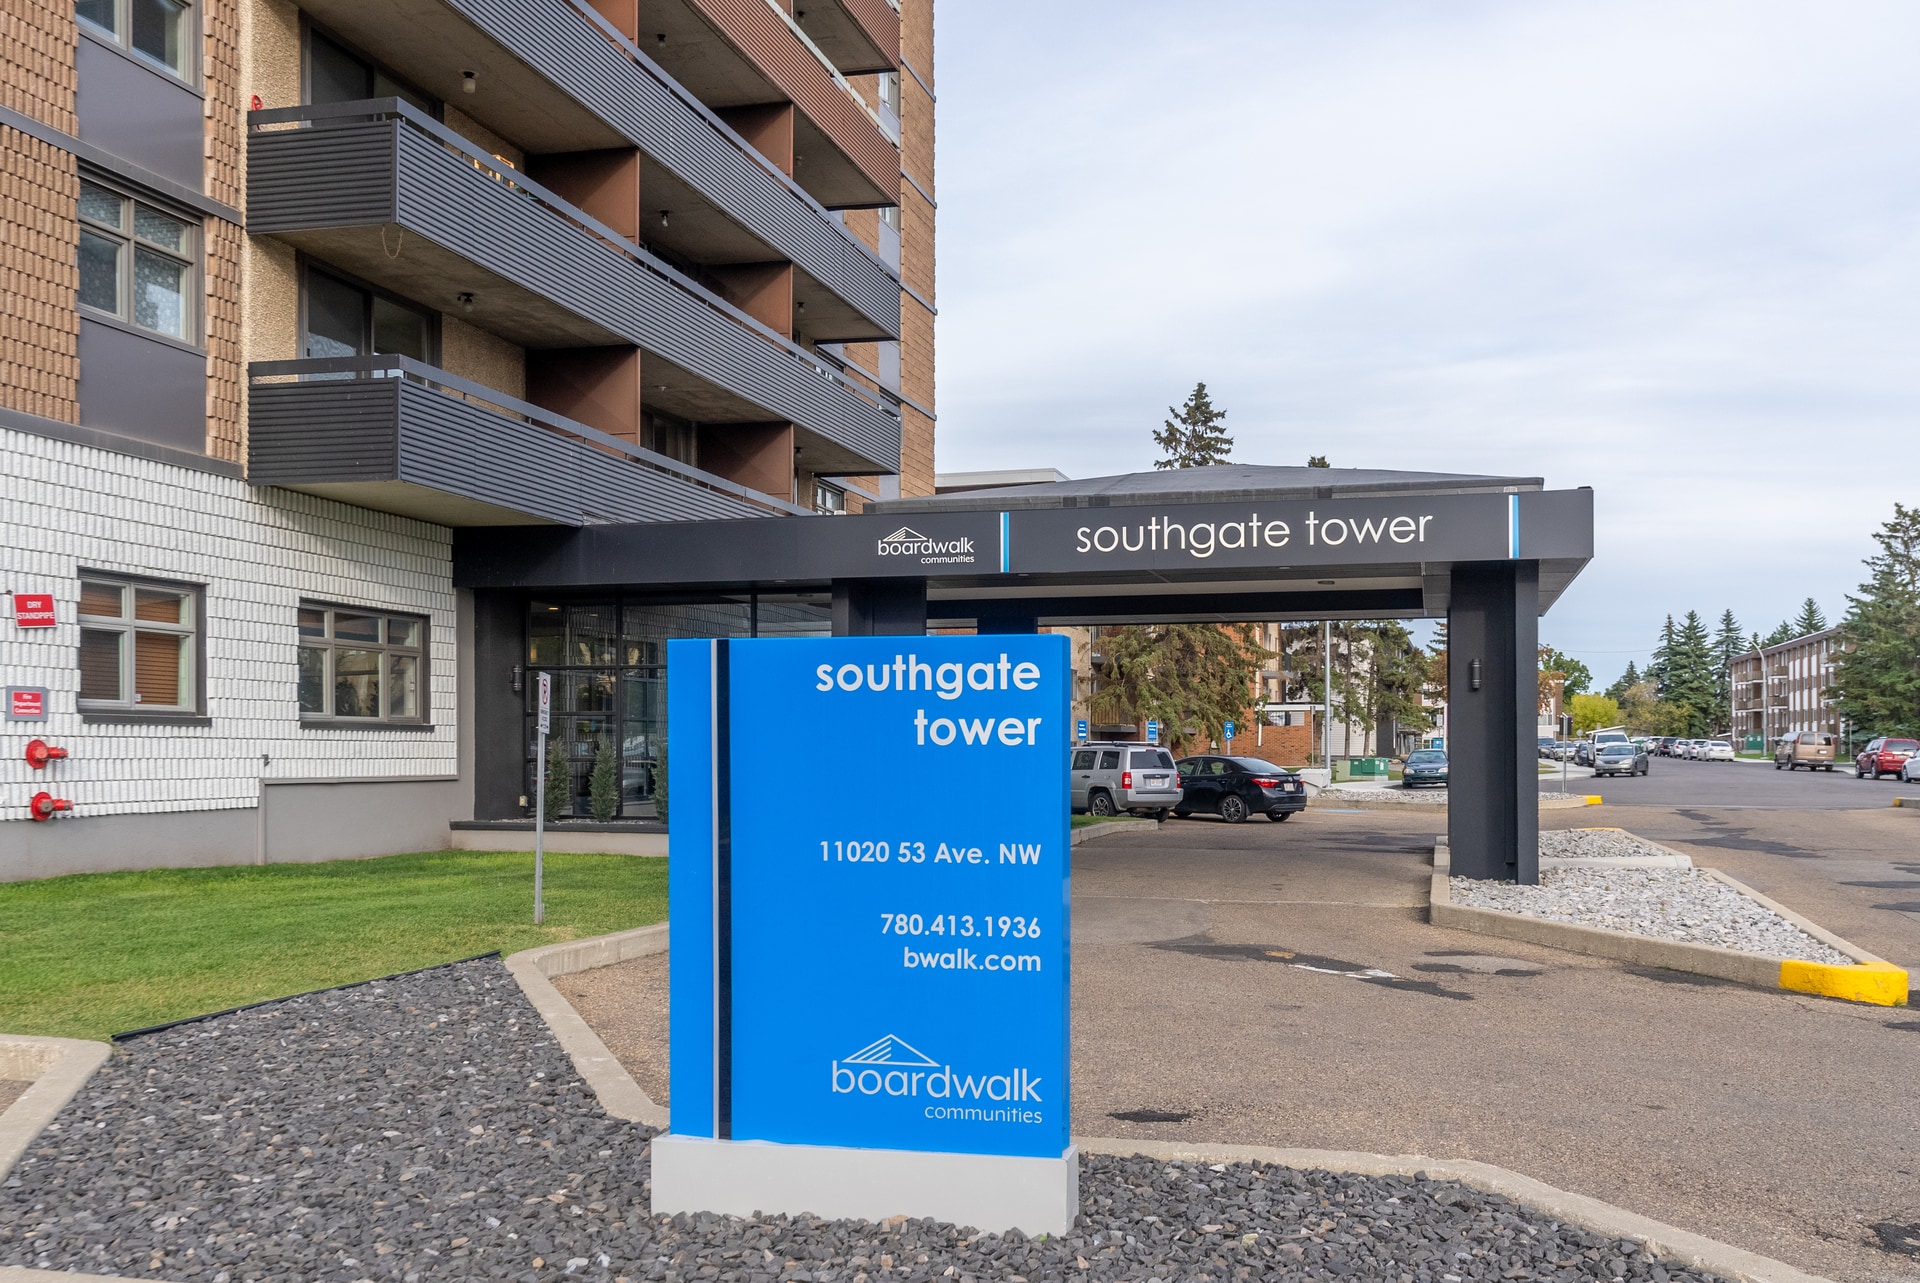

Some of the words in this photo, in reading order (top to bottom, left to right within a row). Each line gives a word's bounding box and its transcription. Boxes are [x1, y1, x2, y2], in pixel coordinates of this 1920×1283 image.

[877, 537, 975, 556] boardwalk
[1076, 513, 1291, 558] southgate
[1305, 511, 1434, 546] tower
[920, 554, 975, 564] communities
[17, 612, 55, 620] STANDPIPE
[815, 653, 1041, 701] southgate
[914, 709, 1041, 746] tower
[820, 841, 890, 864] 11020
[897, 842, 926, 864] 53
[933, 843, 990, 865] Ave.
[999, 844, 1042, 865] NW
[880, 913, 1041, 939] 780.413.1936
[903, 946, 1041, 972] bwalk.com
[832, 1060, 1042, 1102] boardwalk
[924, 1104, 1042, 1124] communities
